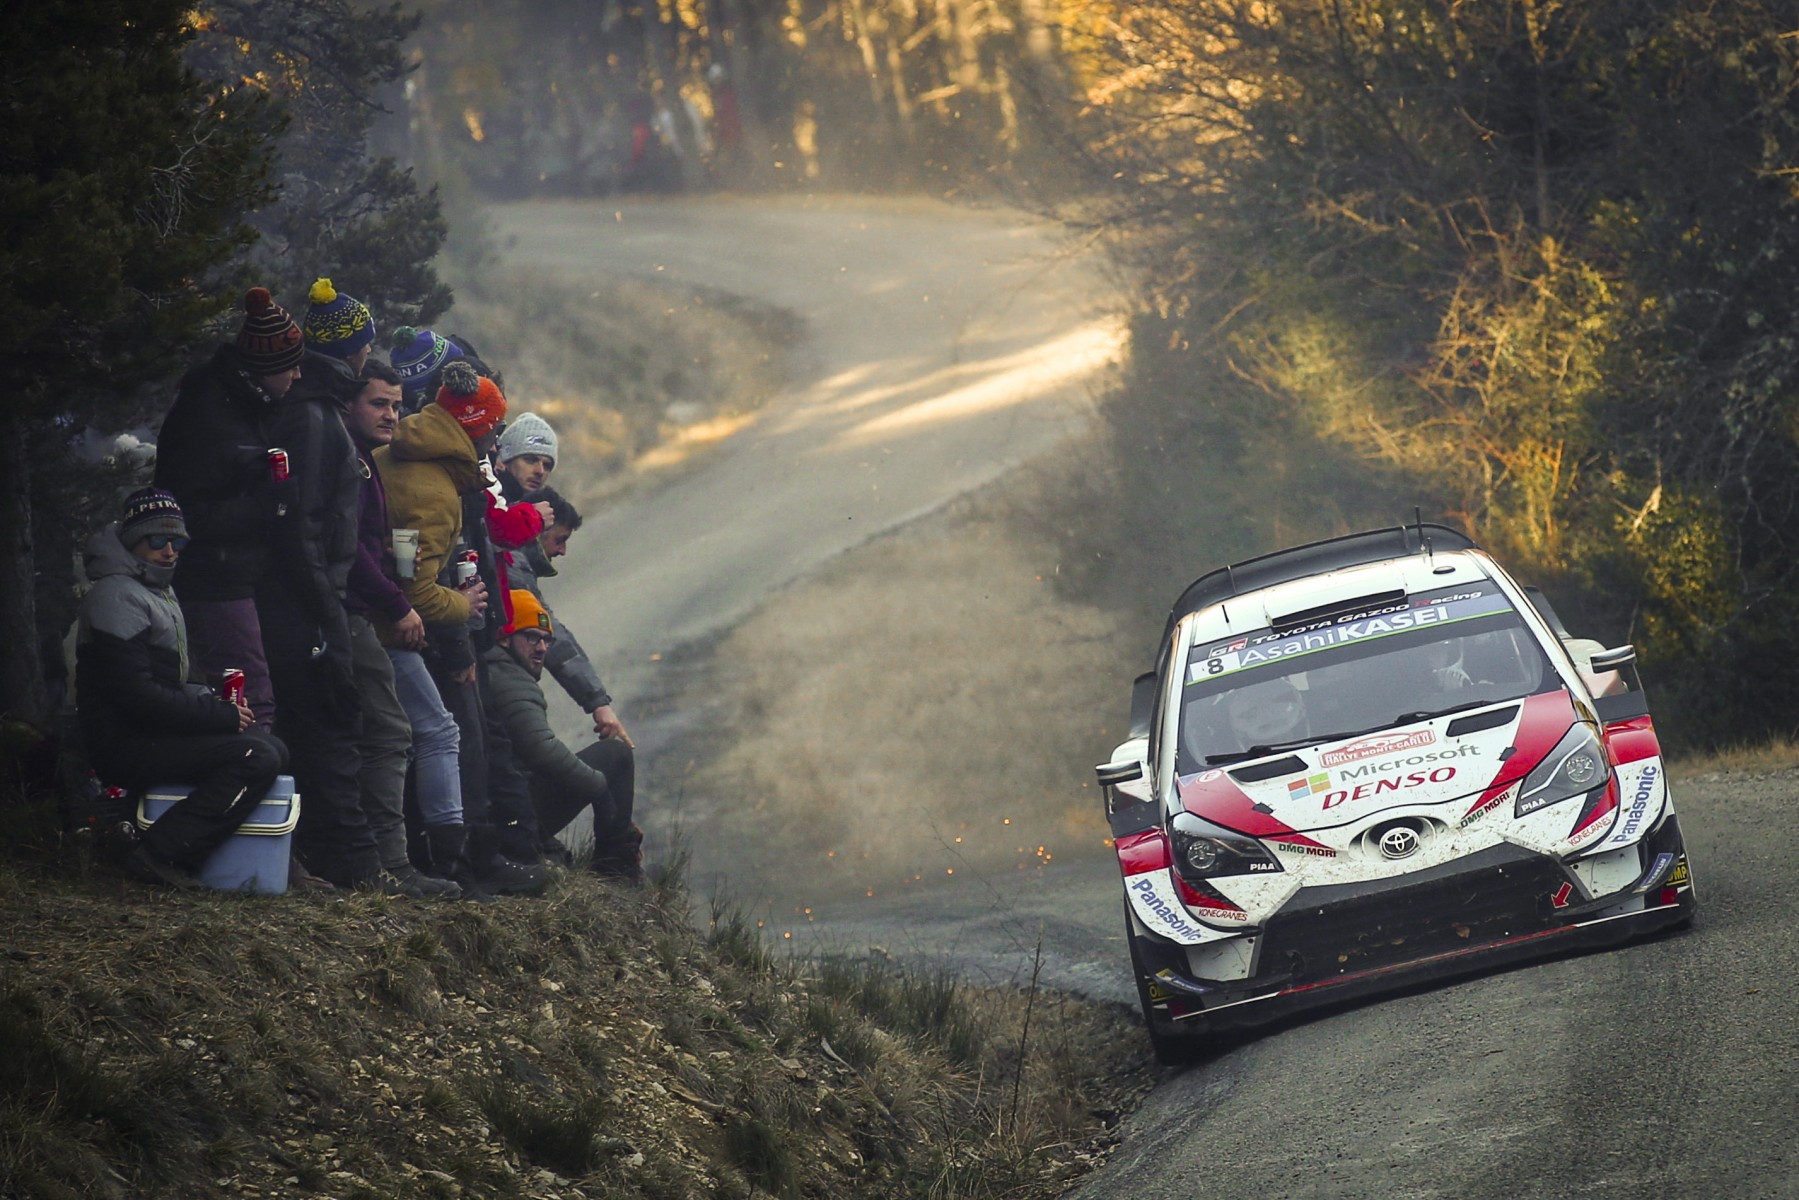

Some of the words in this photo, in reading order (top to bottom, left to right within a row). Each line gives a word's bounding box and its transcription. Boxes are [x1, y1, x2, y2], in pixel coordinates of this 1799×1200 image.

[1211, 641, 1246, 657] GR
[1253, 620, 1332, 645] TOYOTA
[1337, 604, 1410, 624] GAZOO
[1415, 591, 1482, 608] Racing
[1207, 658, 1224, 675] 8
[1325, 753, 1358, 766] RALLYE
[1340, 744, 1481, 782] Microsoft
[1322, 767, 1456, 811] DENSO
[1460, 809, 1484, 828] DMG
[1484, 791, 1510, 813] MORI
[1521, 798, 1546, 812] PIAA
[1611, 766, 1657, 843] Panasonic
[1568, 817, 1612, 846] KONECRANES
[1279, 843, 1305, 854] DMG
[1306, 847, 1337, 858] MORI
[1250, 863, 1275, 871] PIAA
[1132, 878, 1202, 941] Panasonic
[1199, 908, 1248, 921] KONECRANES
